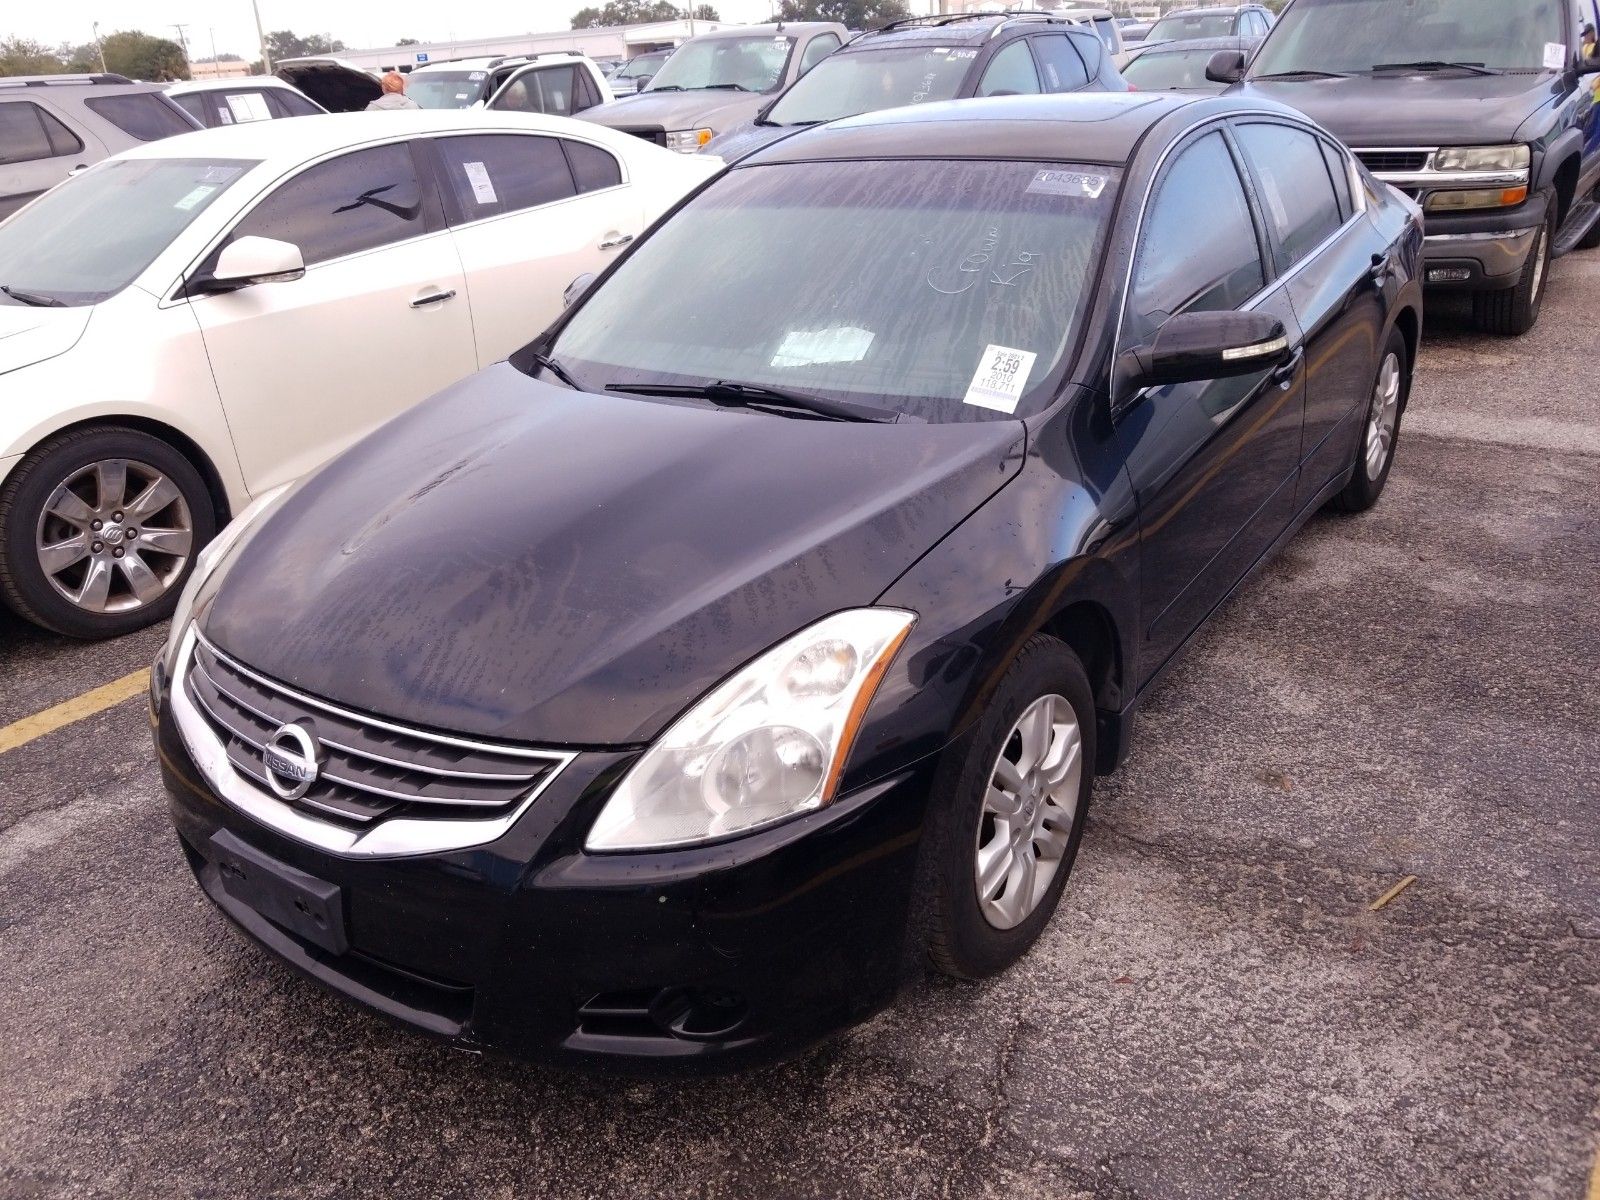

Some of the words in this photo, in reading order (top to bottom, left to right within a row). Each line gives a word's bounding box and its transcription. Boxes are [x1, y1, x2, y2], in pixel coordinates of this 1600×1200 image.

[990, 356, 1020, 374] 2:59
[990, 370, 1014, 383] 2010
[264, 752, 307, 779] NISSAN
